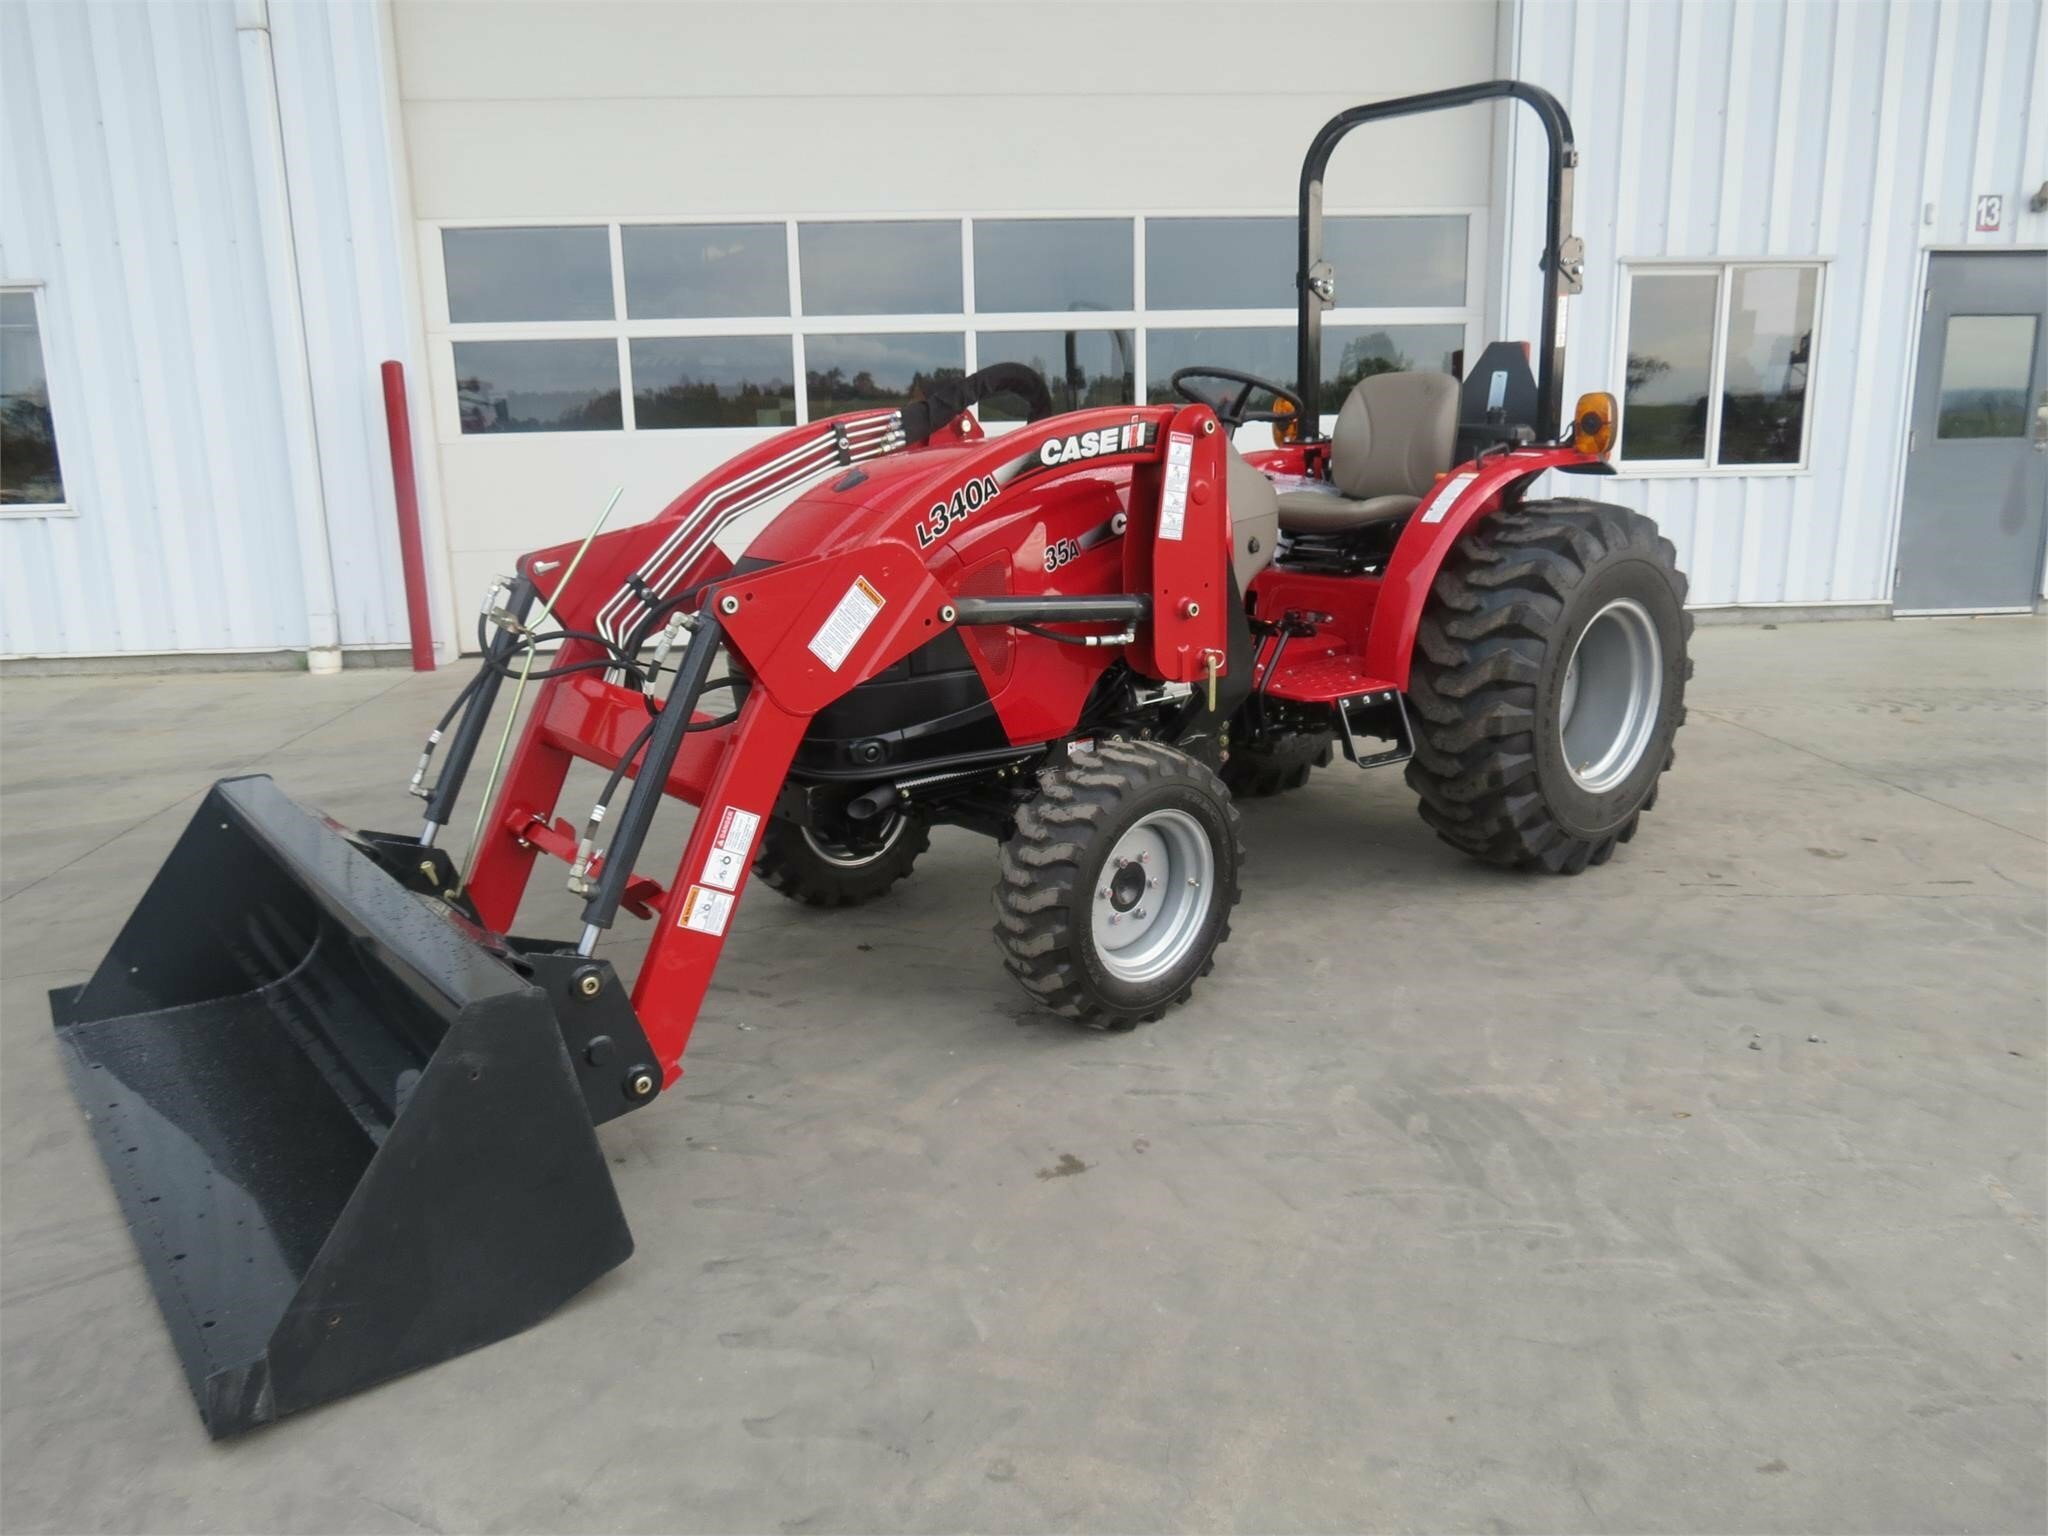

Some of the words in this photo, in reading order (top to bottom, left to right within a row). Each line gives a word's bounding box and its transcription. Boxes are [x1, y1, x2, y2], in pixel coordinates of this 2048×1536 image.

[1978, 196, 2000, 227] 13
[1040, 427, 1119, 466] CASE
[915, 473, 1000, 550] L340A
[1044, 537, 1080, 573] 35A
